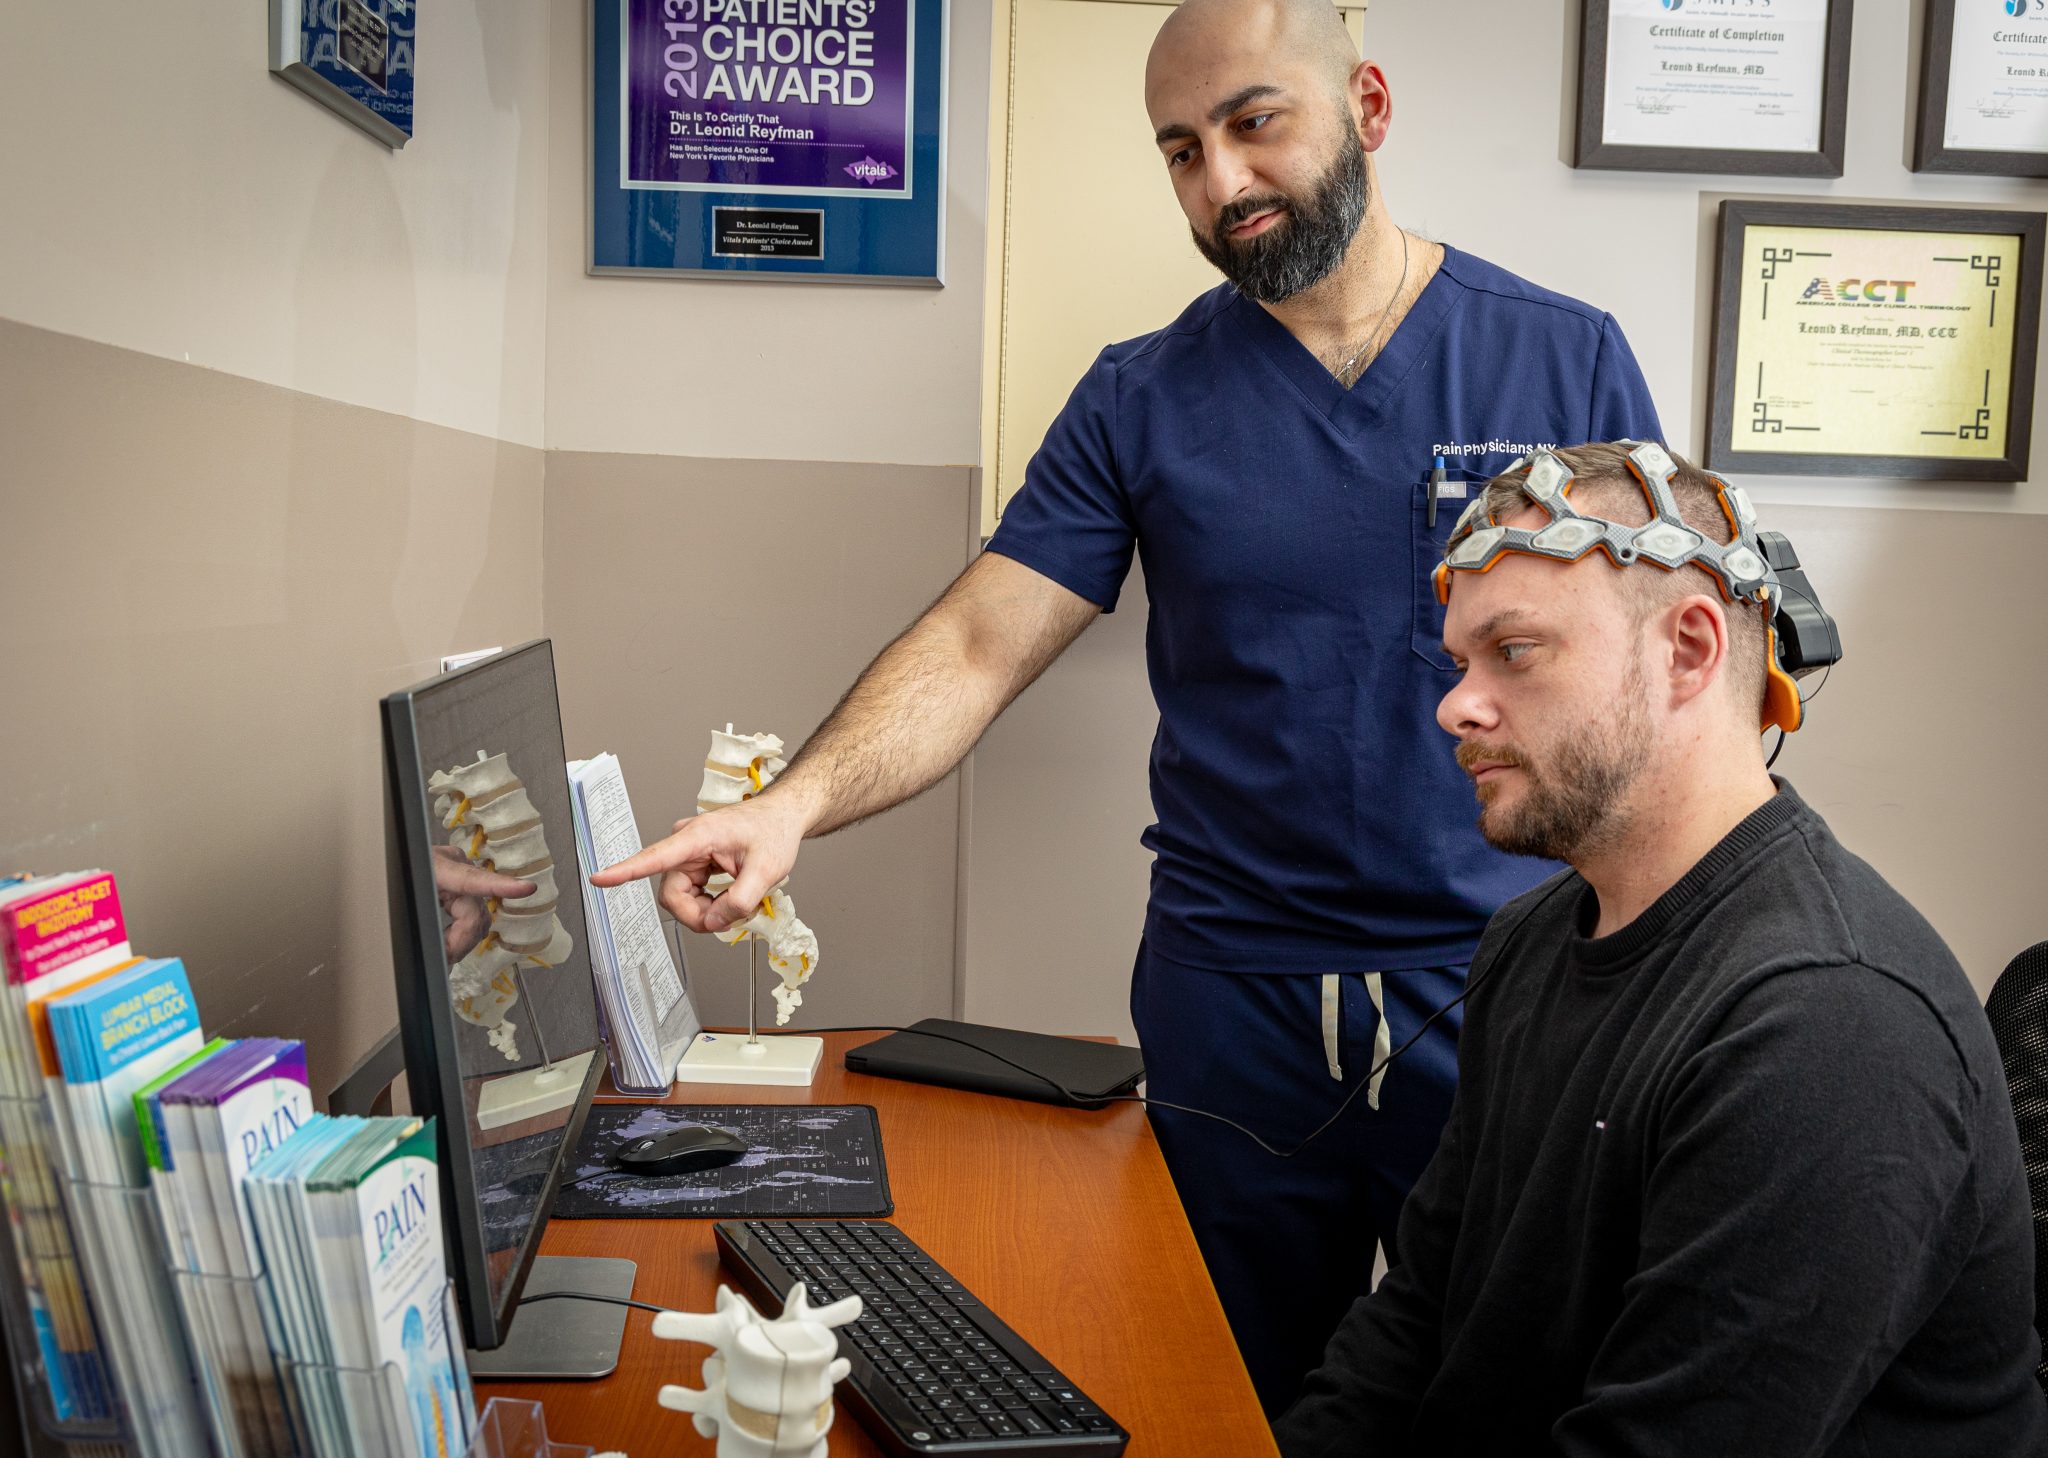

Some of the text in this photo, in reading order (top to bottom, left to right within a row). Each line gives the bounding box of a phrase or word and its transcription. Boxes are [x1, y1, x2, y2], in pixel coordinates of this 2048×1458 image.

[703, 0, 875, 28] PATIENTS'
[1649, 25, 1785, 42] Certificate of Completion
[1993, 30, 2048, 44] Certificate
[664, 0, 698, 99] 2013
[702, 24, 874, 66] CHOICE
[1661, 60, 1765, 75] Leonid Reyfman, MD
[2006, 66, 2036, 76] Leonid
[702, 64, 874, 106] AWARD
[669, 110, 779, 125] This Is To Certify That
[670, 121, 814, 141] Dr. Leonid Reyfman
[669, 143, 683, 151] Has
[685, 144, 702, 152] Been
[704, 145, 732, 153] Selected
[734, 146, 743, 154] As
[760, 147, 768, 155] Of
[669, 152, 775, 163] New York's Favorite Physicians
[854, 164, 887, 177] vitals
[736, 221, 799, 231] Dr. Leonid Reyfman
[722, 236, 741, 244] Vitals
[791, 238, 813, 246] Award
[760, 244, 775, 252] 2013
[1802, 277, 1916, 302] ACCT
[1798, 322, 1959, 339] Leonid Reyfman, MD, CCT
[1433, 441, 1461, 456] Pain
[1463, 438, 1533, 456] Physicians
[77, 880, 111, 904] FACET
[102, 980, 178, 1027] LUMBAR MEDIAL
[101, 993, 188, 1051] BRANCH BLOCK
[242, 1096, 300, 1171] PAIN
[374, 1172, 426, 1252] PAIN
